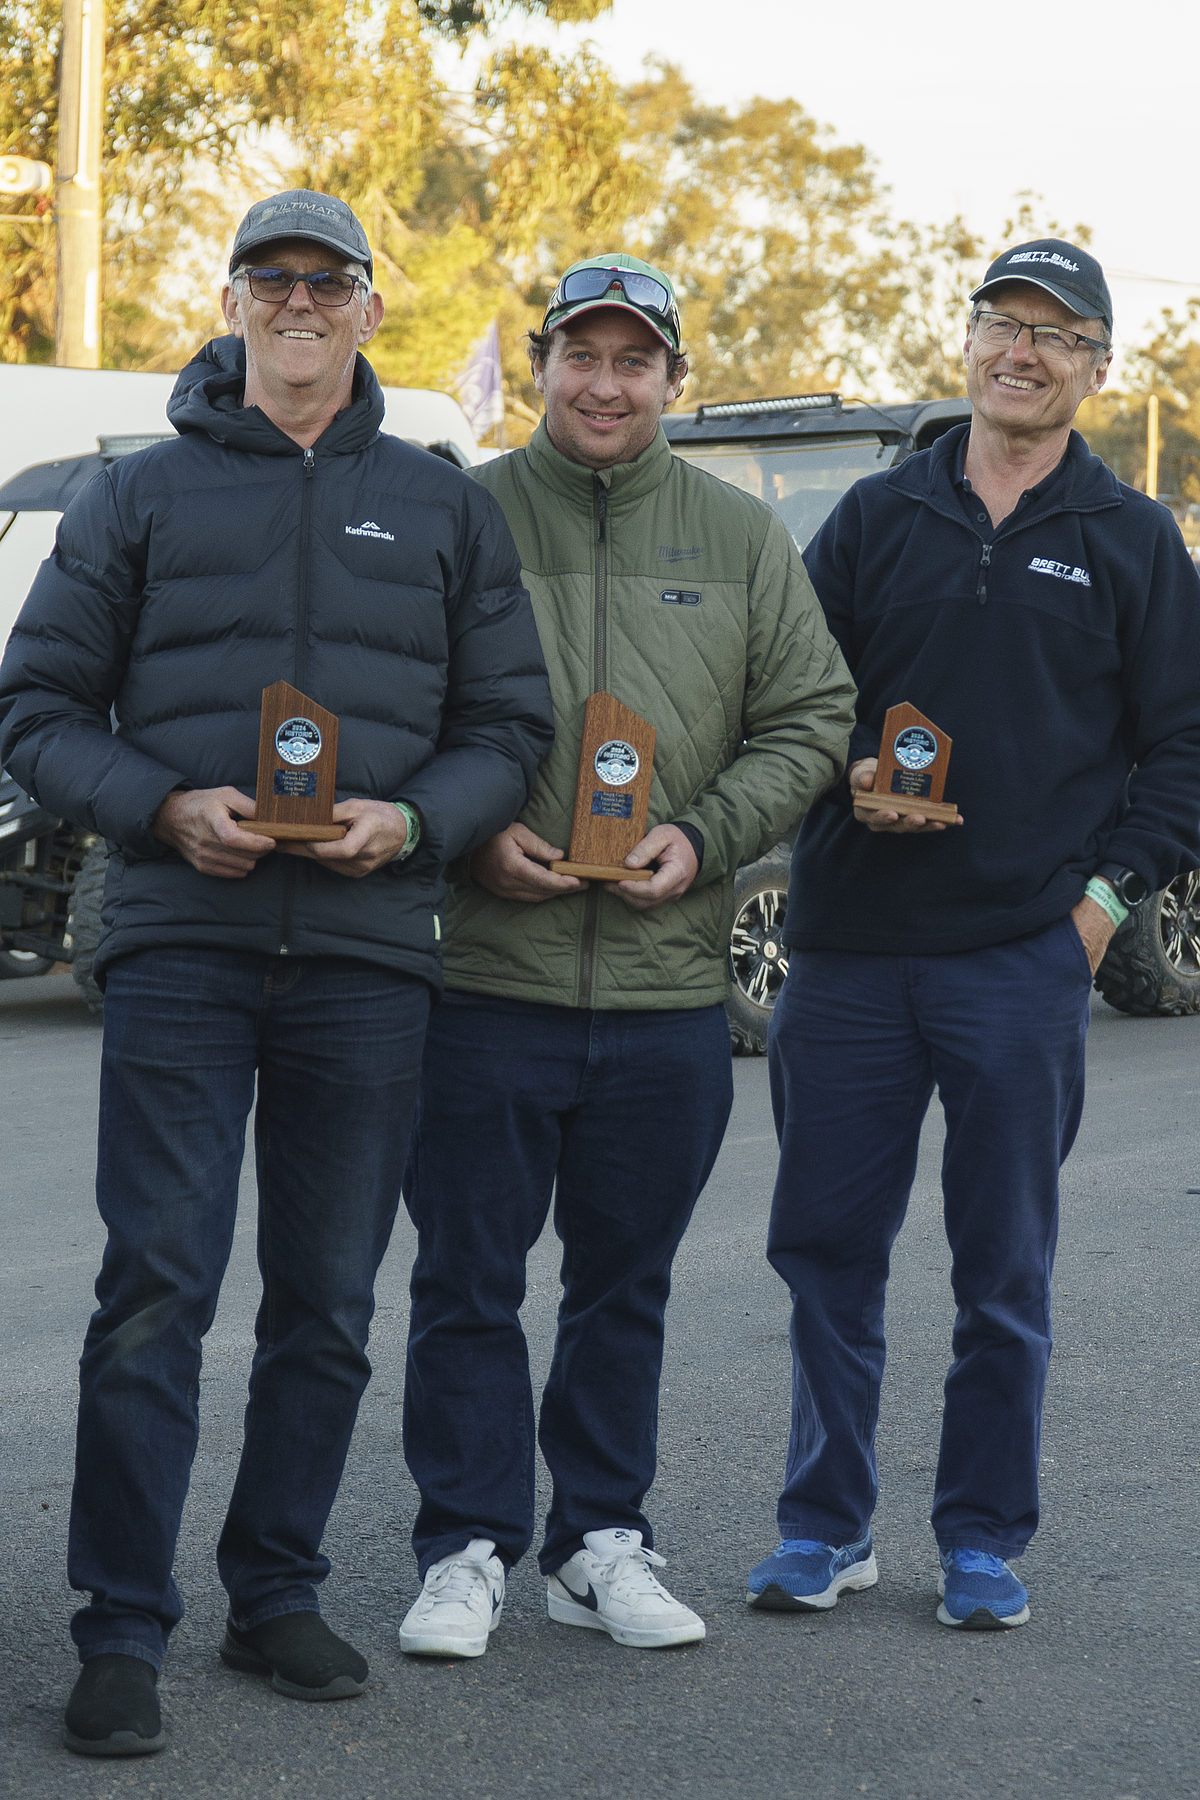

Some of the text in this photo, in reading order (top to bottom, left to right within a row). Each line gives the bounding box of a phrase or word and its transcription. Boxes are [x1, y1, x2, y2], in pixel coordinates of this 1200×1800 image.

[345, 525, 394, 541] Kathmandu
[1031, 557, 1071, 574] BRETT
[284, 730, 313, 738] HISTORIC
[903, 737, 930, 747] HISTORIC
[603, 752, 631, 760] HISTORIC
